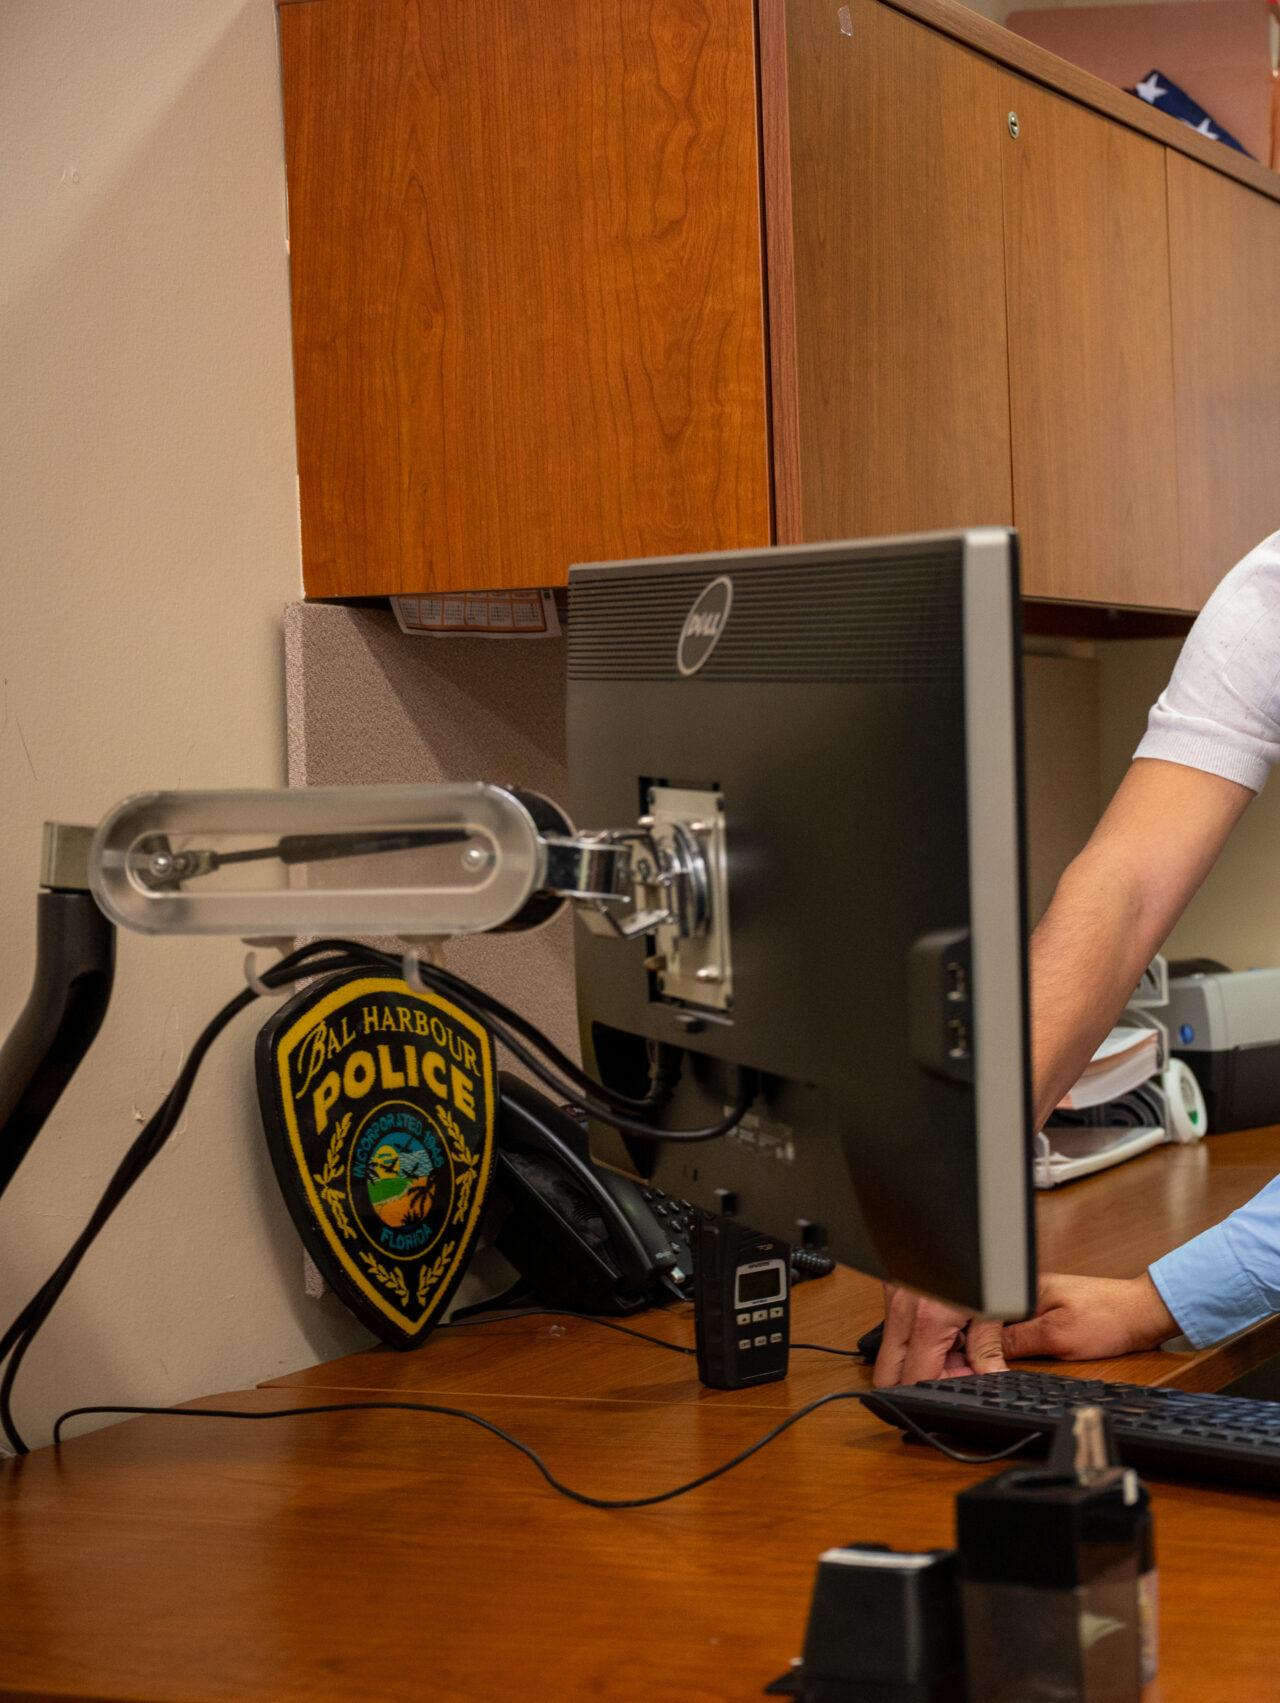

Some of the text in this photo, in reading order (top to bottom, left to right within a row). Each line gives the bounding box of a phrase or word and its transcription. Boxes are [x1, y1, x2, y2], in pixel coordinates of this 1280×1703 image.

[362, 1006, 481, 1077] HARBOUR
[312, 1044, 476, 1135] POLICE
[380, 1224, 432, 1250] FLORIDA
